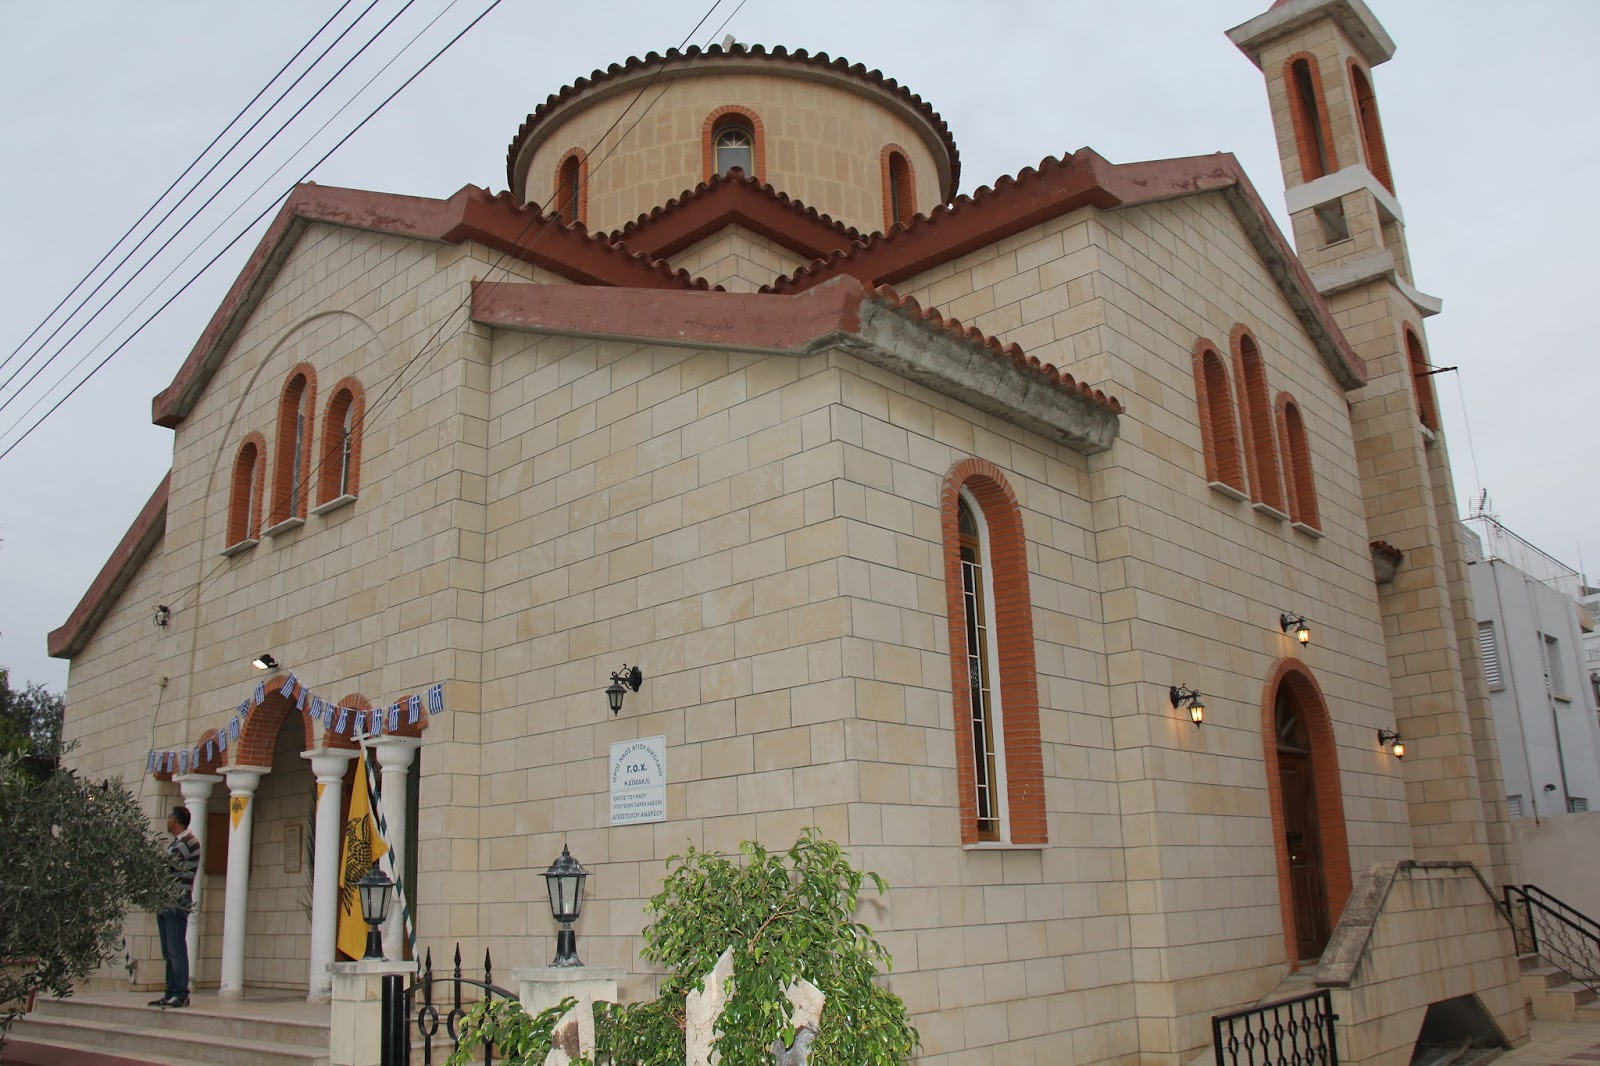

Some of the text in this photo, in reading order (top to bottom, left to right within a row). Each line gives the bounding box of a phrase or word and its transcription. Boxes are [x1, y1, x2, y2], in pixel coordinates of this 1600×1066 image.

[619, 748, 631, 763] ΝΑΟΣ
[632, 743, 646, 751] ΑΓΙΟΥ
[626, 763, 648, 773] Γ.Ο.Χ.
